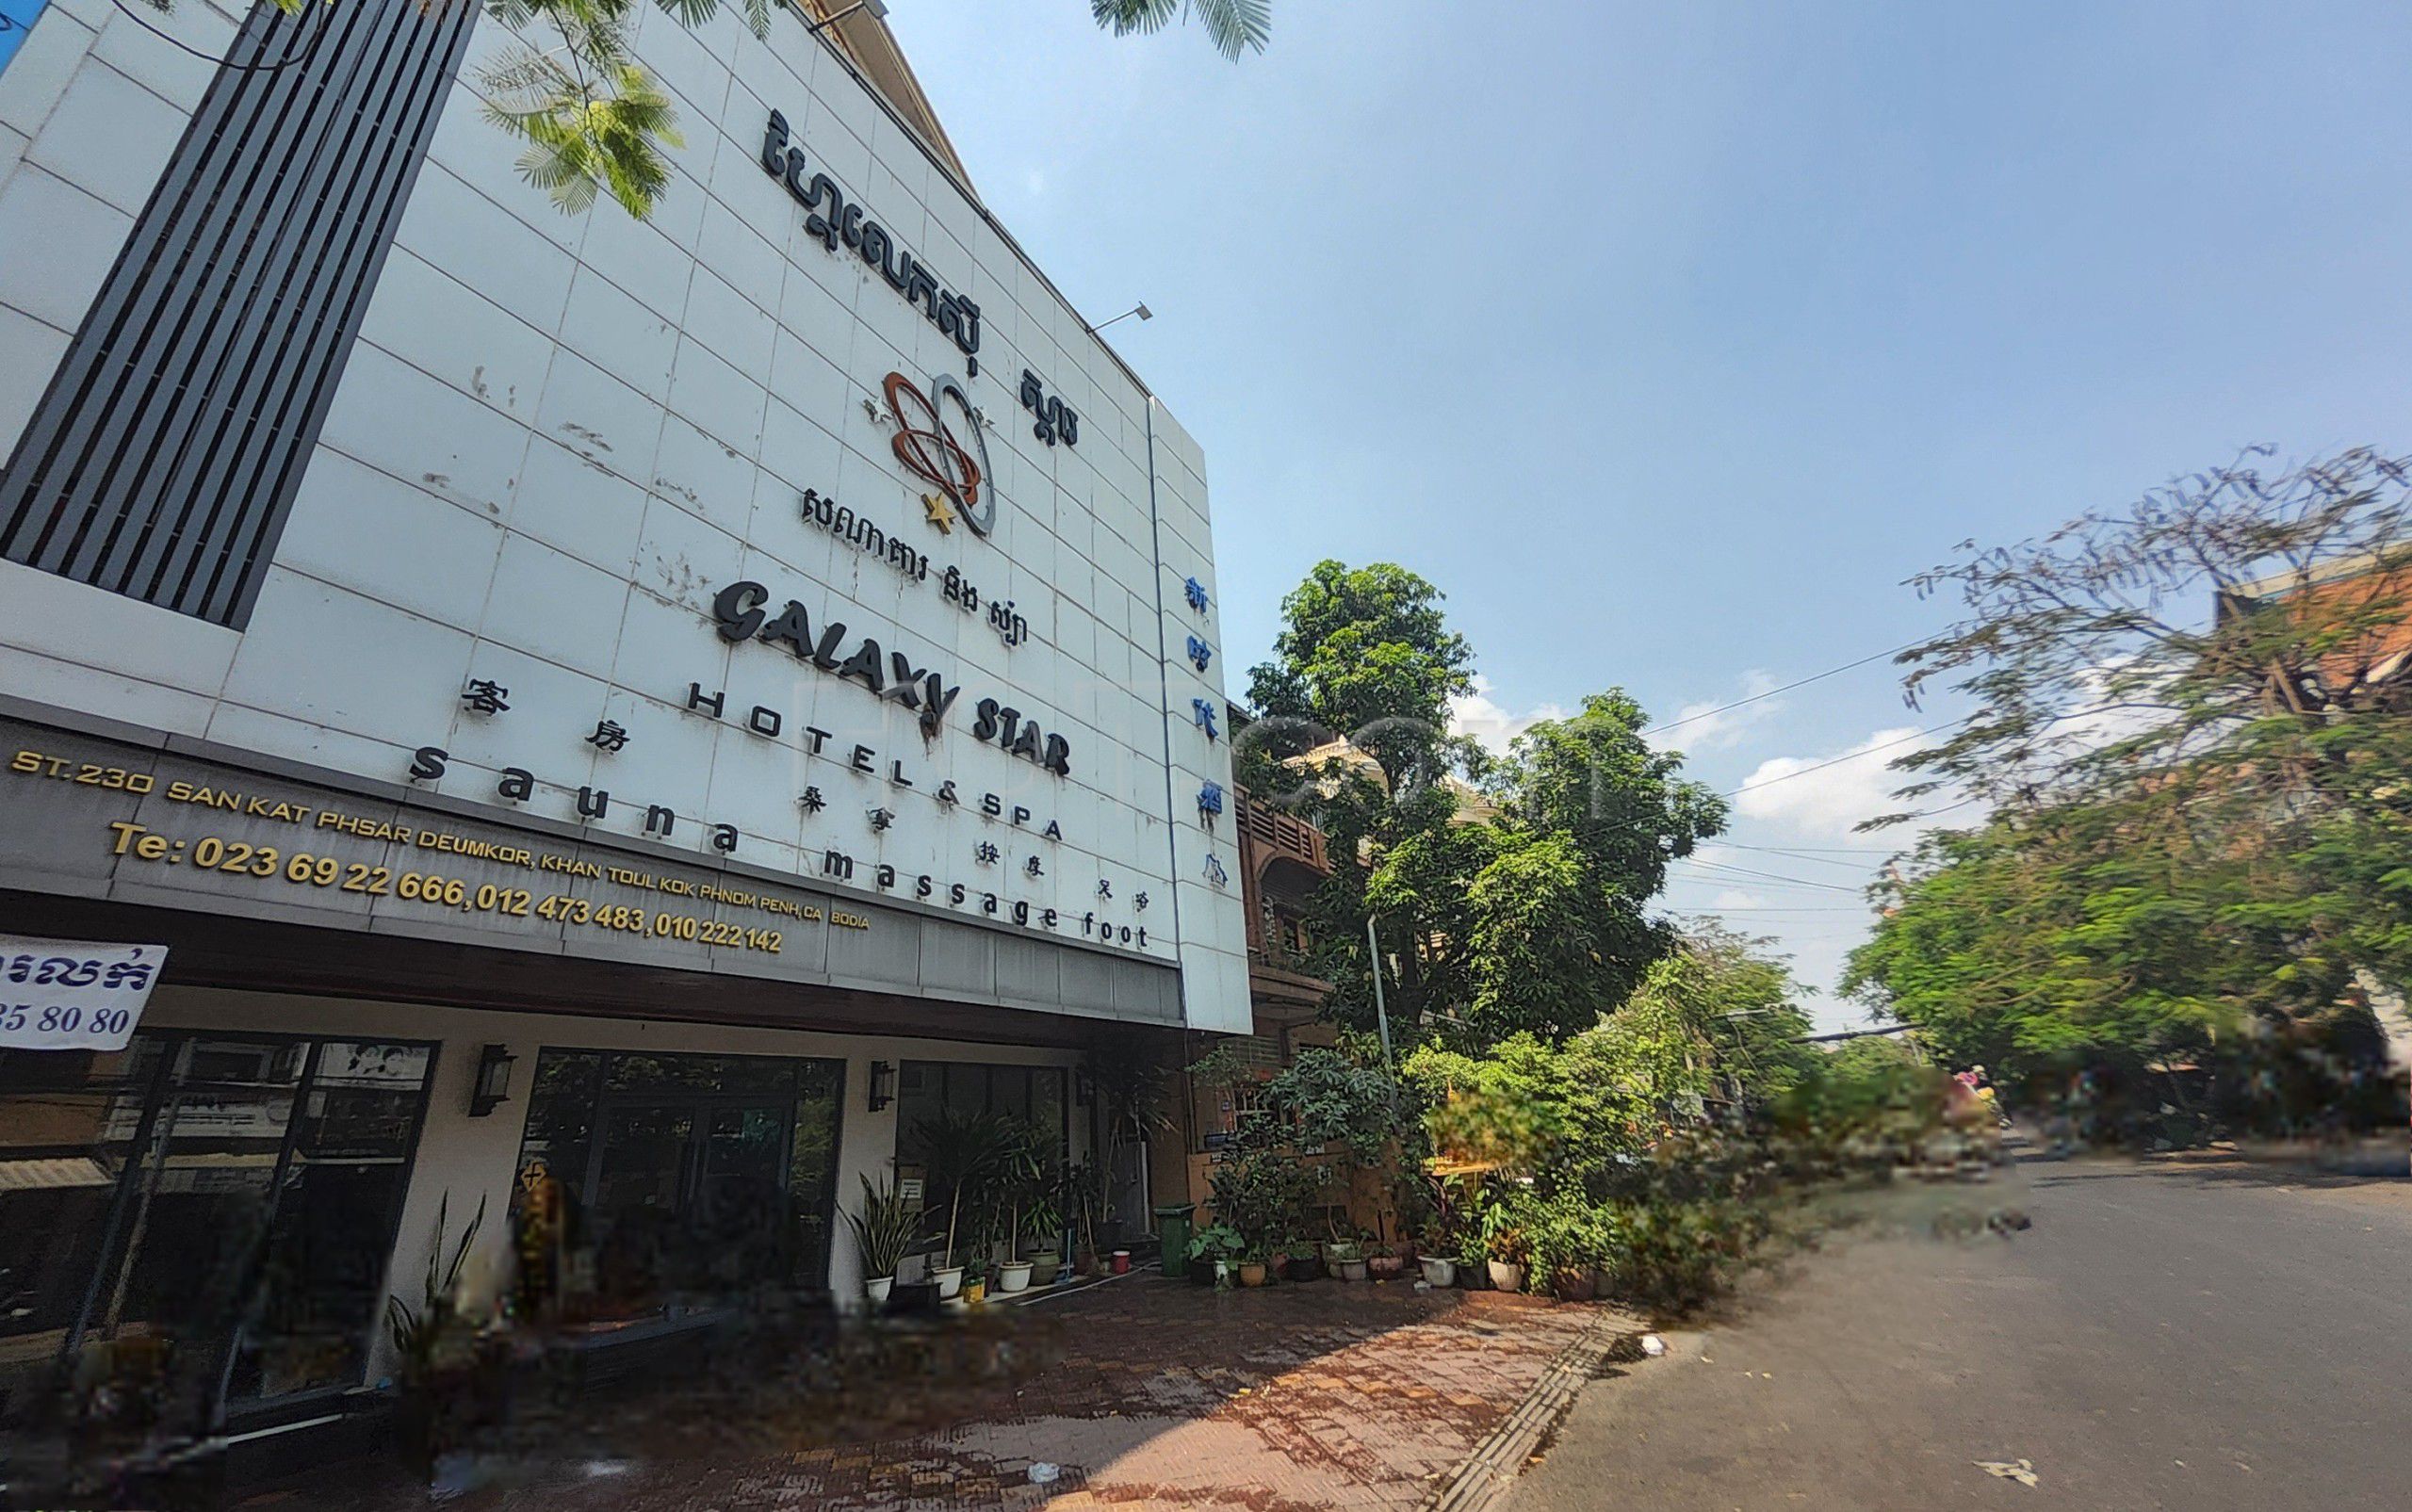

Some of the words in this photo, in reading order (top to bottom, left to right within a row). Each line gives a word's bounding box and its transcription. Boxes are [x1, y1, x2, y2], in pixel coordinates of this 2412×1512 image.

[943, 564, 977, 611] និង
[713, 580, 960, 723] GALAXY
[973, 698, 1070, 776] STAR
[11, 751, 155, 793] ST.230
[318, 812, 411, 842] PHSAR
[418, 830, 535, 870] DEUMKOR,
[542, 854, 602, 878] KHAN
[609, 867, 656, 889] TOUL
[660, 877, 695, 896] KOK
[700, 885, 757, 907] PHNOM
[831, 912, 871, 929] BODIA
[689, 682, 912, 786] HOTEL
[983, 793, 1062, 841] SPA
[111, 821, 186, 862] Te:
[195, 837, 279, 876] 023
[287, 853, 338, 886] 69
[342, 864, 392, 894] 22
[536, 895, 591, 923] 473
[699, 921, 742, 946] 222
[746, 931, 783, 952] 142
[409, 746, 737, 853] sauna
[823, 850, 1057, 926] massage
[1084, 912, 1148, 947] foot
[37, 1006, 82, 1032] 80
[89, 1008, 130, 1034] 80
